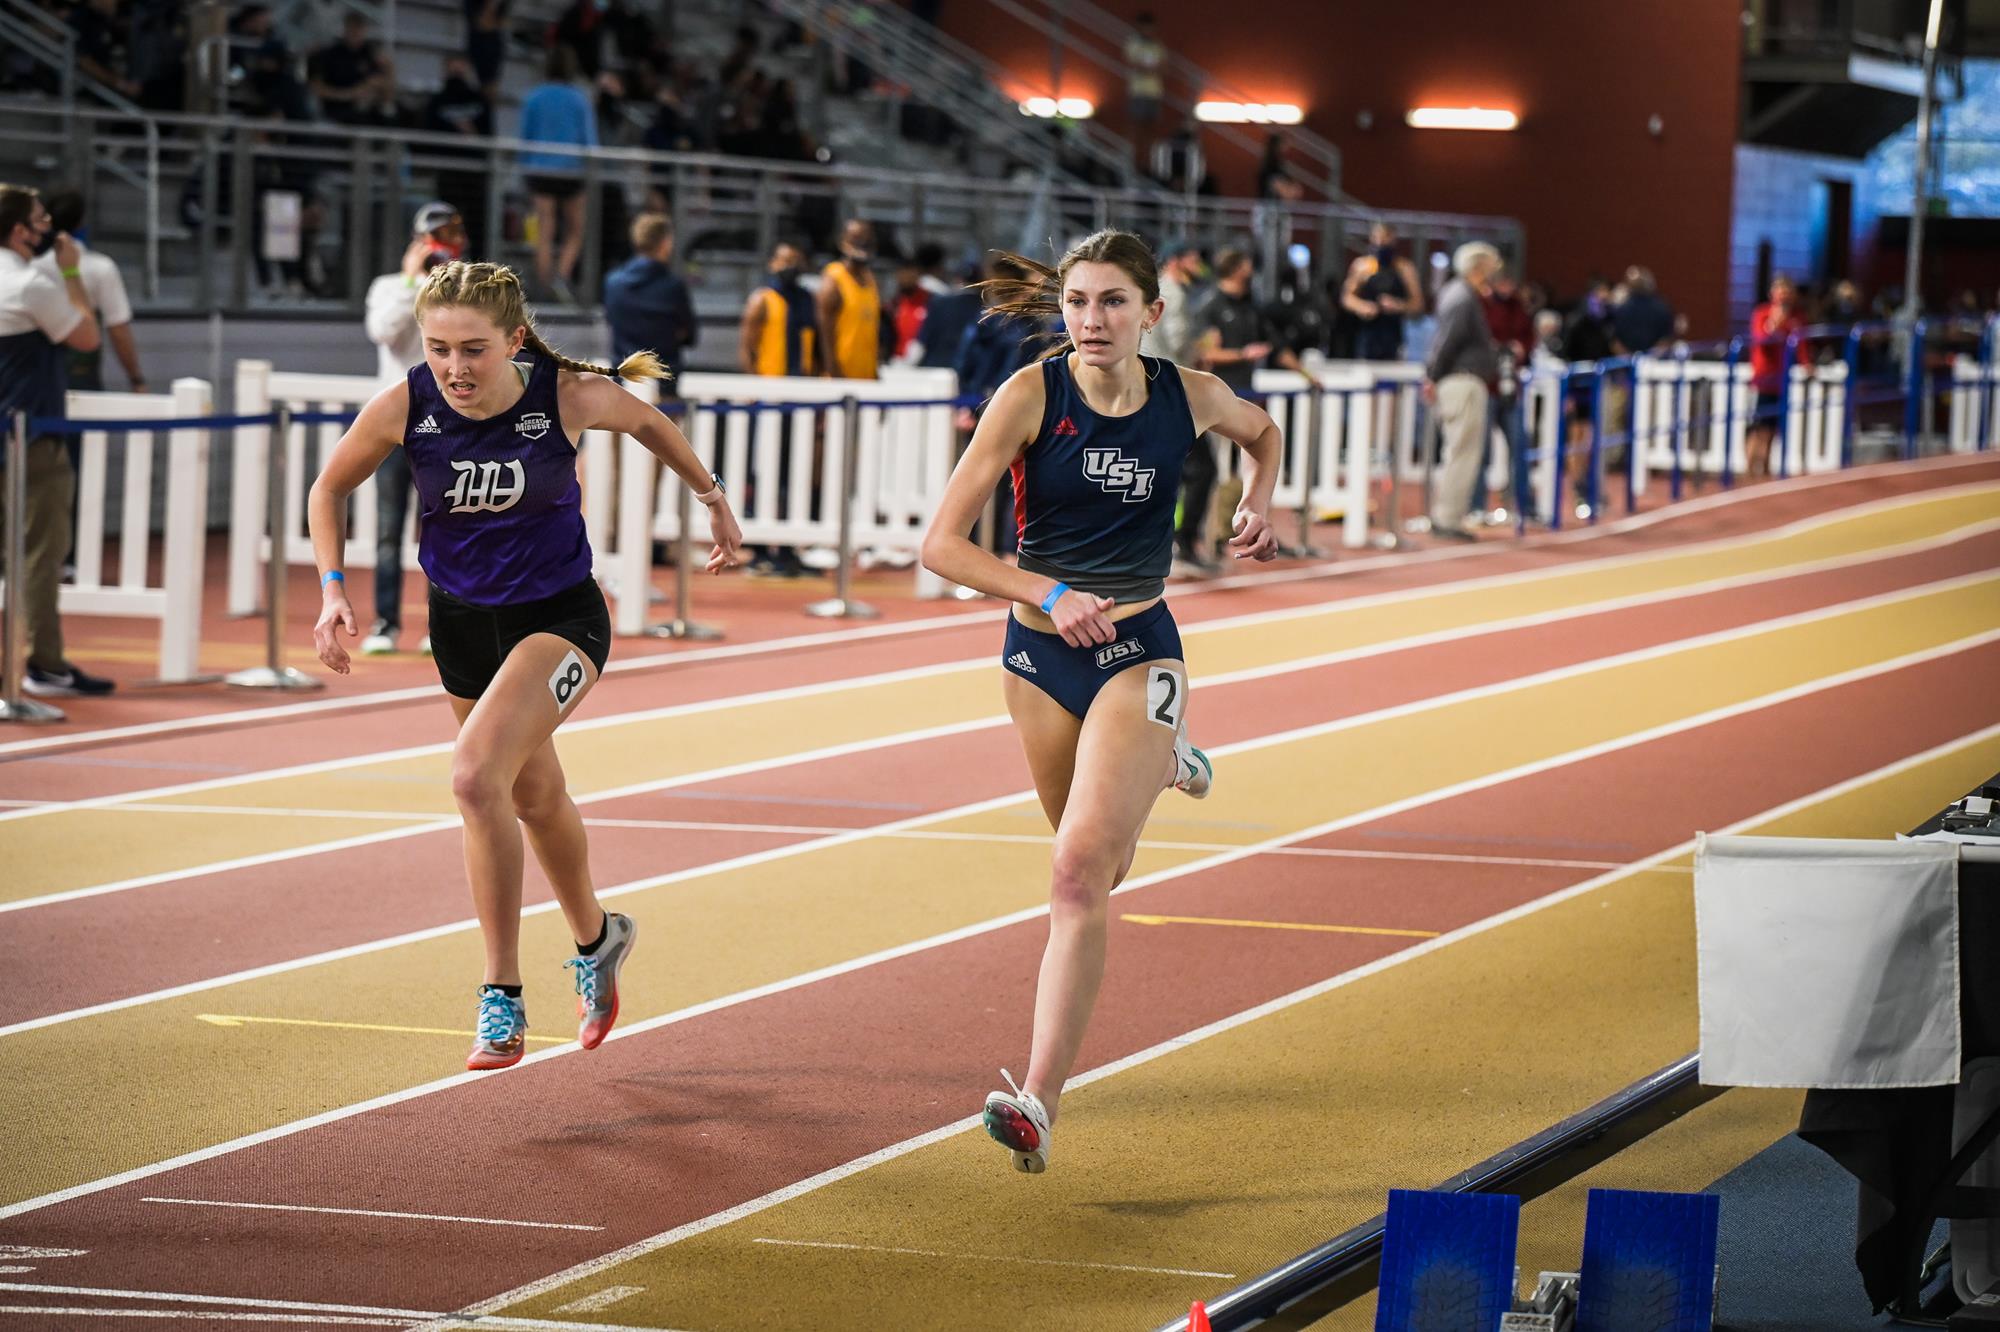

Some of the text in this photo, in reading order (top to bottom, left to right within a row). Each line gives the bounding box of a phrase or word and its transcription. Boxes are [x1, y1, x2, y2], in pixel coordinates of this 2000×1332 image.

[415, 426, 441, 434] adidas
[1085, 450, 1153, 499] USI
[1008, 657, 1037, 674] adidas
[1097, 640, 1142, 666] USI
[556, 662, 582, 704] 8
[1155, 672, 1177, 725] 2
